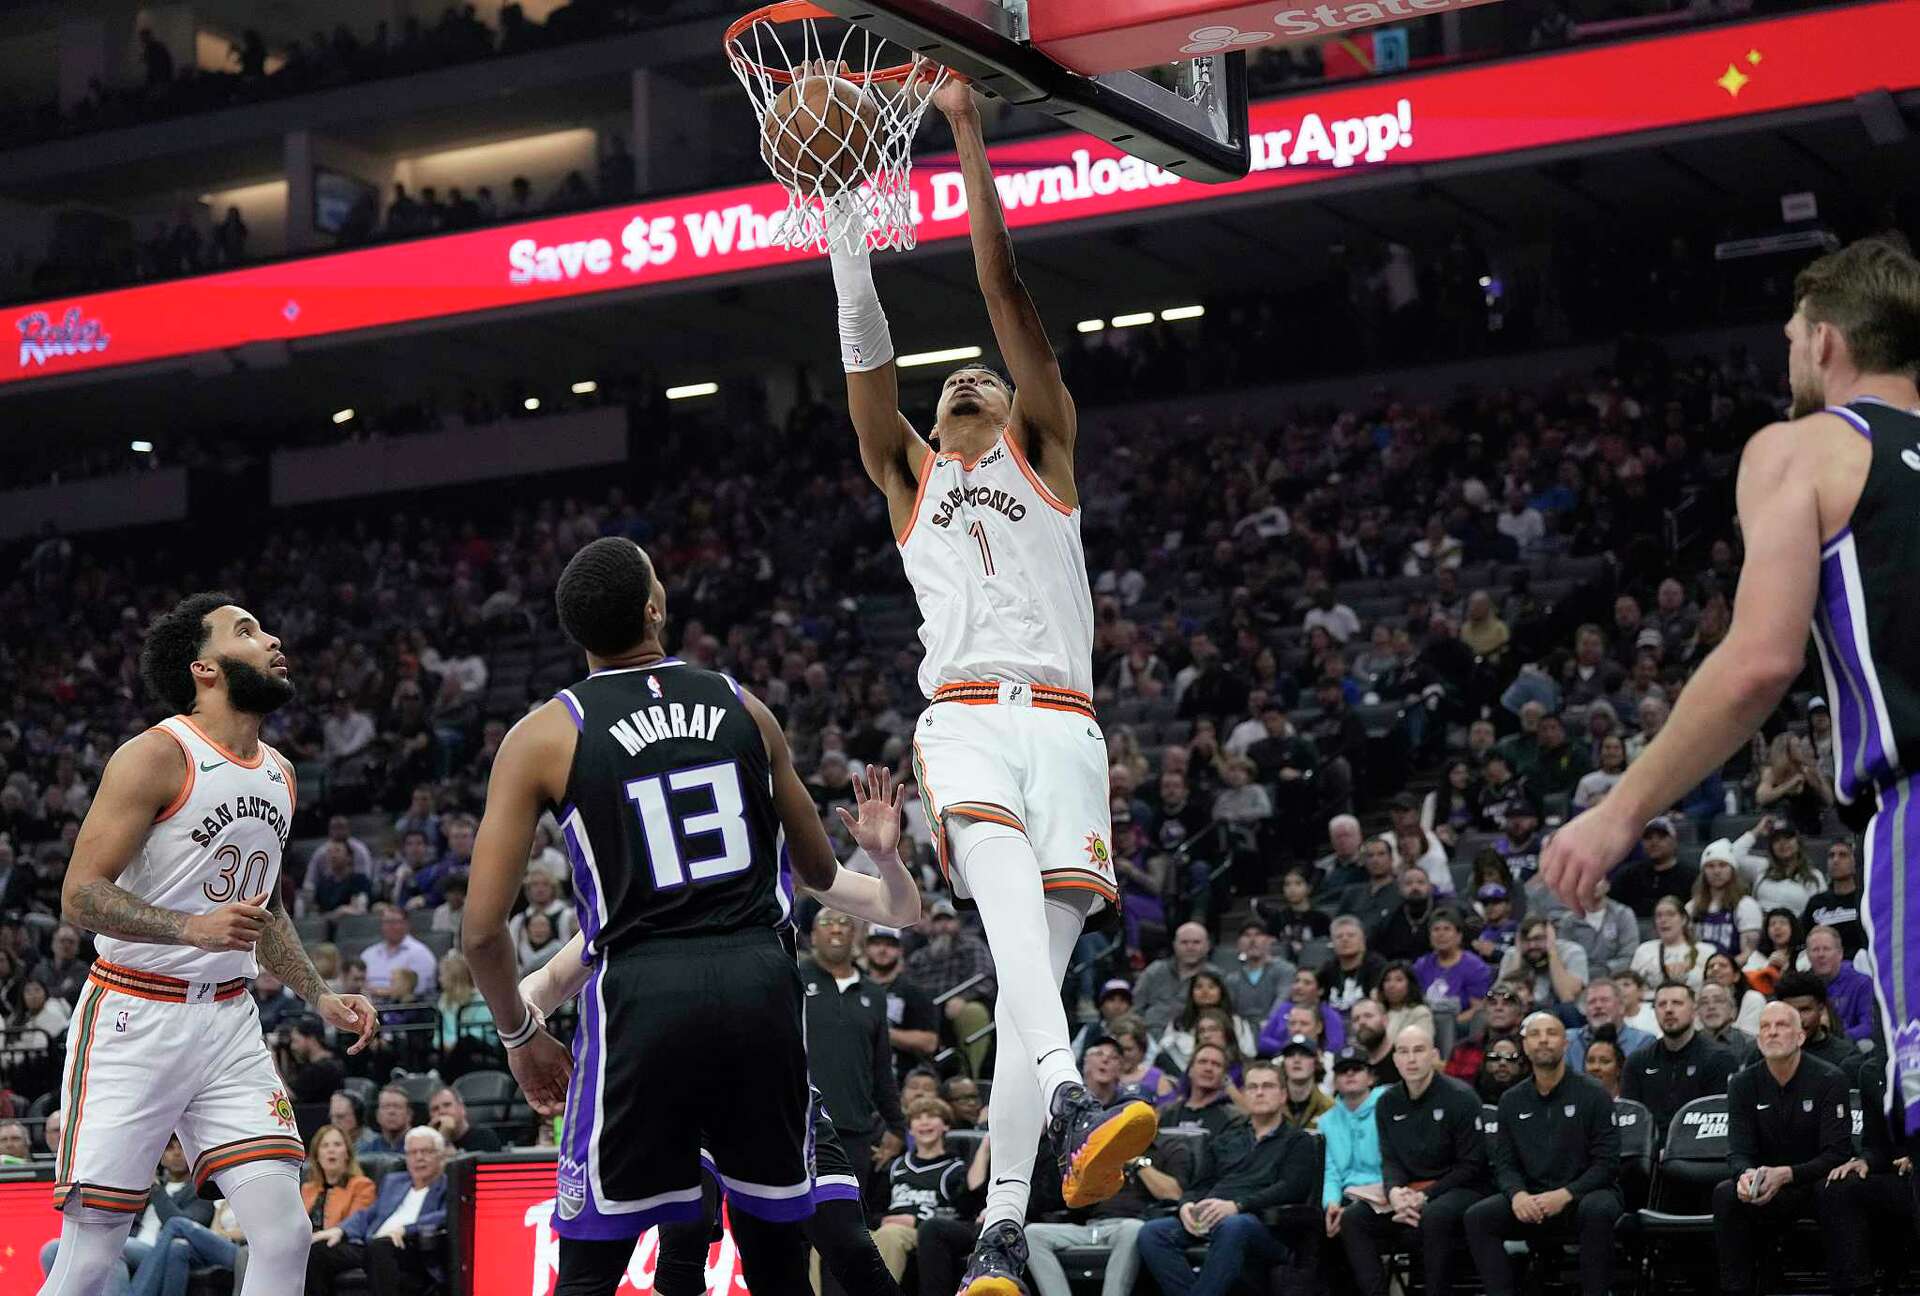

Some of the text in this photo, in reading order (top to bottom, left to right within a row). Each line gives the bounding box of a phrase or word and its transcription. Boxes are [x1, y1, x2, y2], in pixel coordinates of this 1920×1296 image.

[509, 239, 613, 284] Save
[621, 216, 677, 272] $5
[930, 150, 1182, 221] Dwnloa
[1289, 99, 1413, 168] App!
[980, 447, 1005, 469] Self.
[968, 520, 995, 577] 1
[608, 702, 727, 758] MURRAY
[191, 803, 234, 848] SAN
[624, 759, 751, 891] 13
[203, 844, 269, 903] 30
